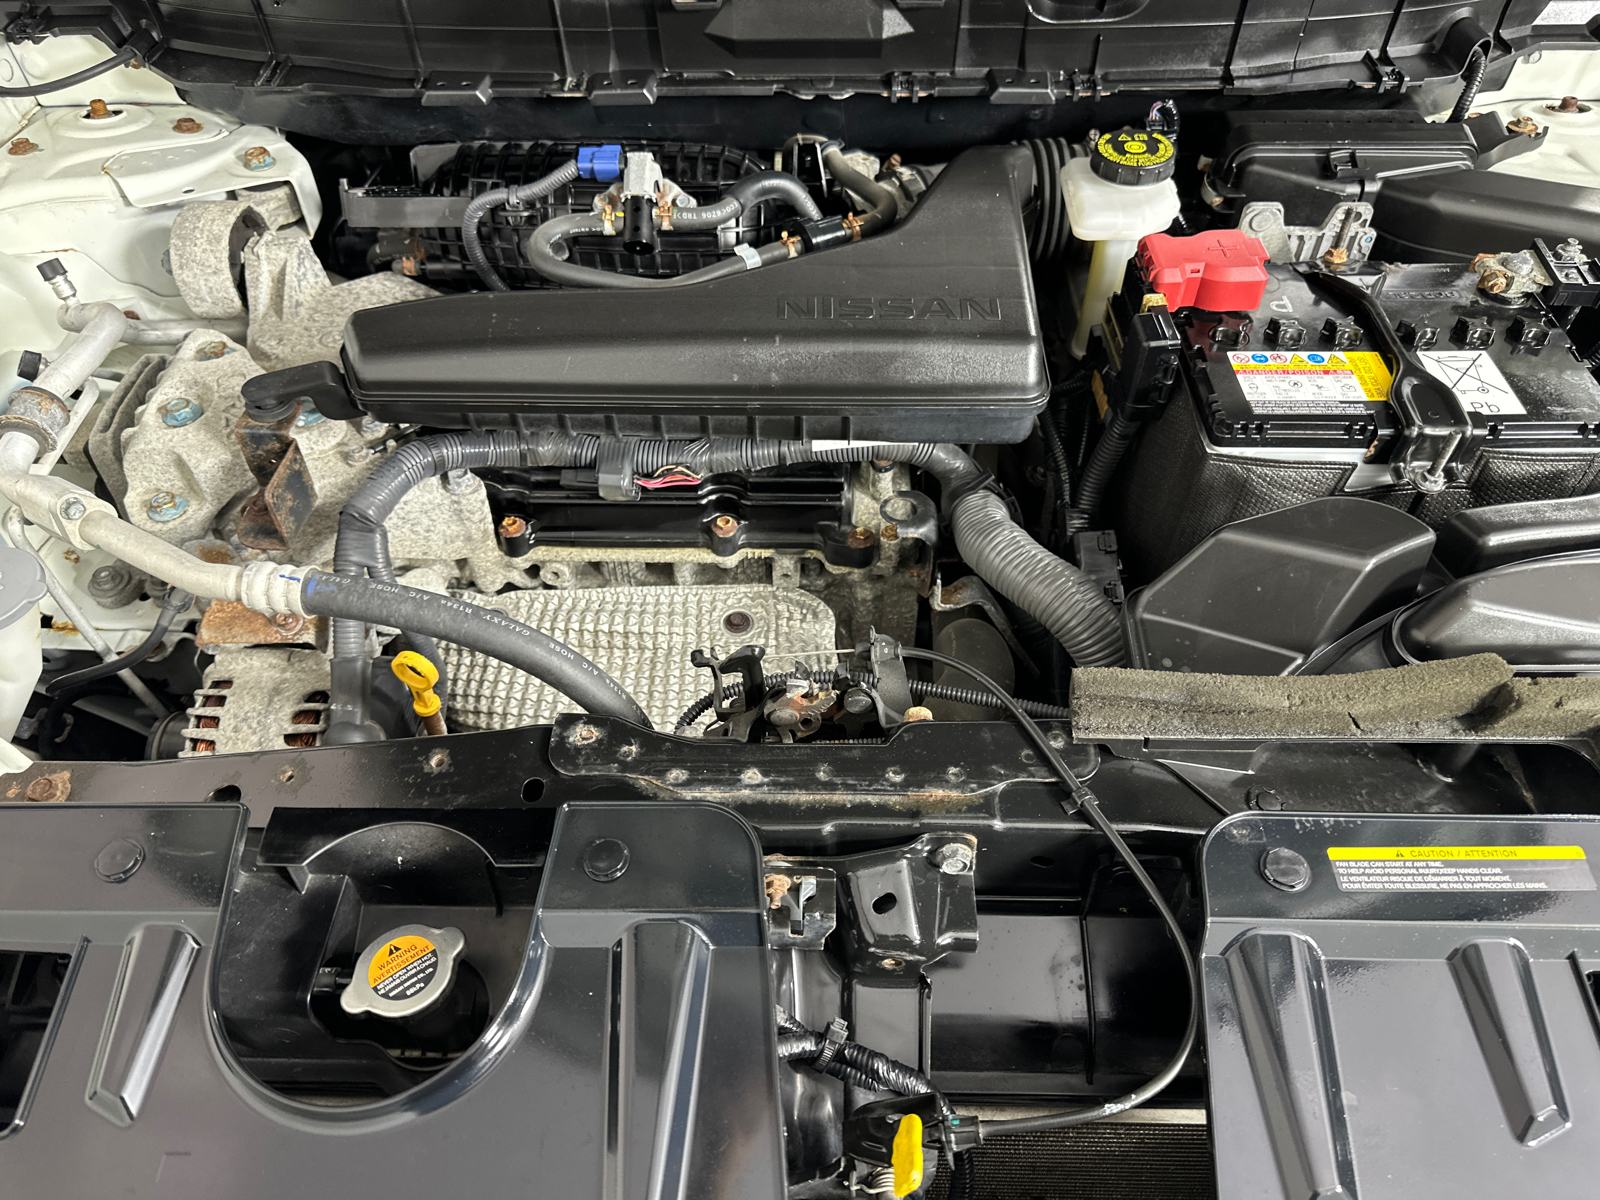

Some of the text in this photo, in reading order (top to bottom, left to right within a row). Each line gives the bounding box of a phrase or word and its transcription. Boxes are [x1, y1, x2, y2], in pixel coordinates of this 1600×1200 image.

[777, 297, 1002, 320] NISSAN
[1470, 402, 1500, 413] Pb
[370, 584, 399, 593] HOSE
[409, 592, 430, 600] A/C
[483, 615, 530, 636] GALAXY
[549, 642, 575, 660] HOSE
[582, 662, 599, 676] A/C
[373, 945, 431, 984] AVERTISSEMENT
[378, 944, 418, 971] WARNING
[377, 977, 393, 990] NEVER
[393, 968, 407, 979] OPEN
[406, 959, 422, 971] WHEN
[385, 978, 400, 991] JAMAIS
[400, 968, 416, 981] OUVRIR
